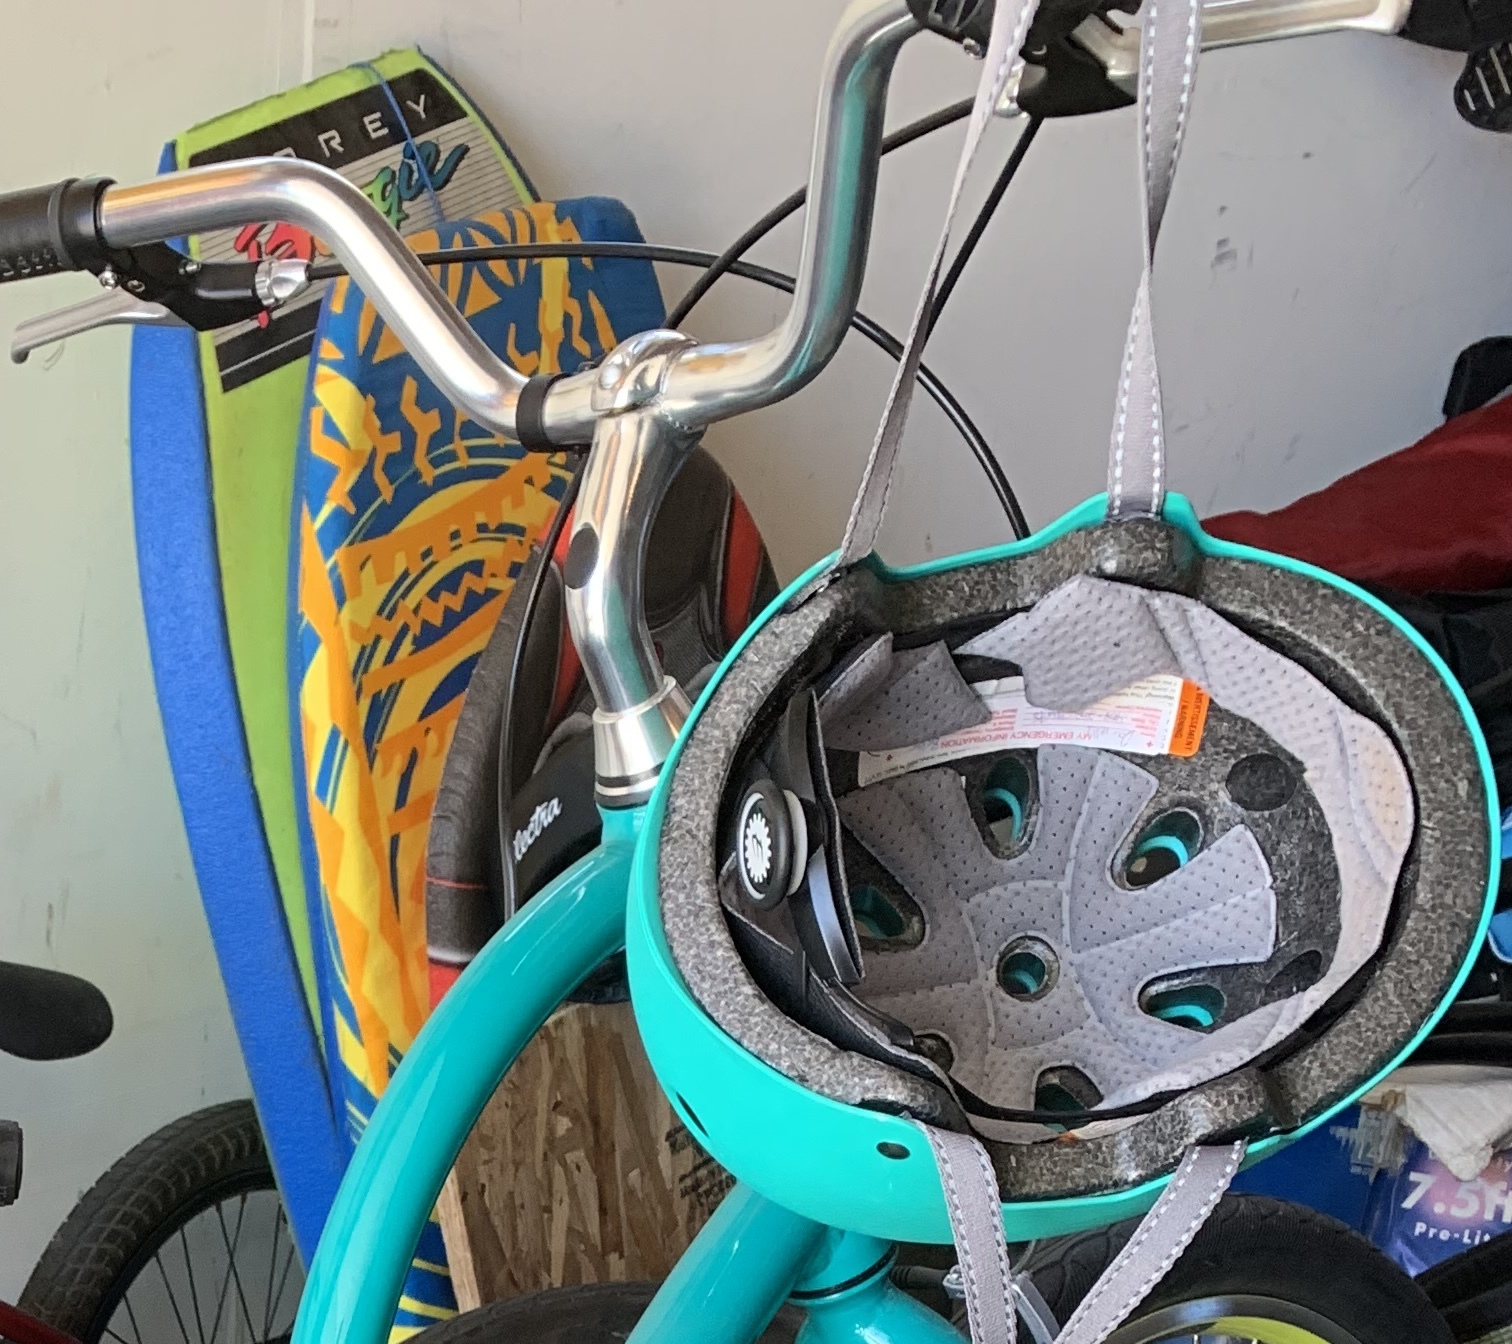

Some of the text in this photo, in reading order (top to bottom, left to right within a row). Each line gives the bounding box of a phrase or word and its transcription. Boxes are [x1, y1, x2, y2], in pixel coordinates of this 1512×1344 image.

[936, 731, 1008, 749] INFORMATION
[1008, 730, 1074, 741] EMERGENCY
[1075, 732, 1092, 741] MY
